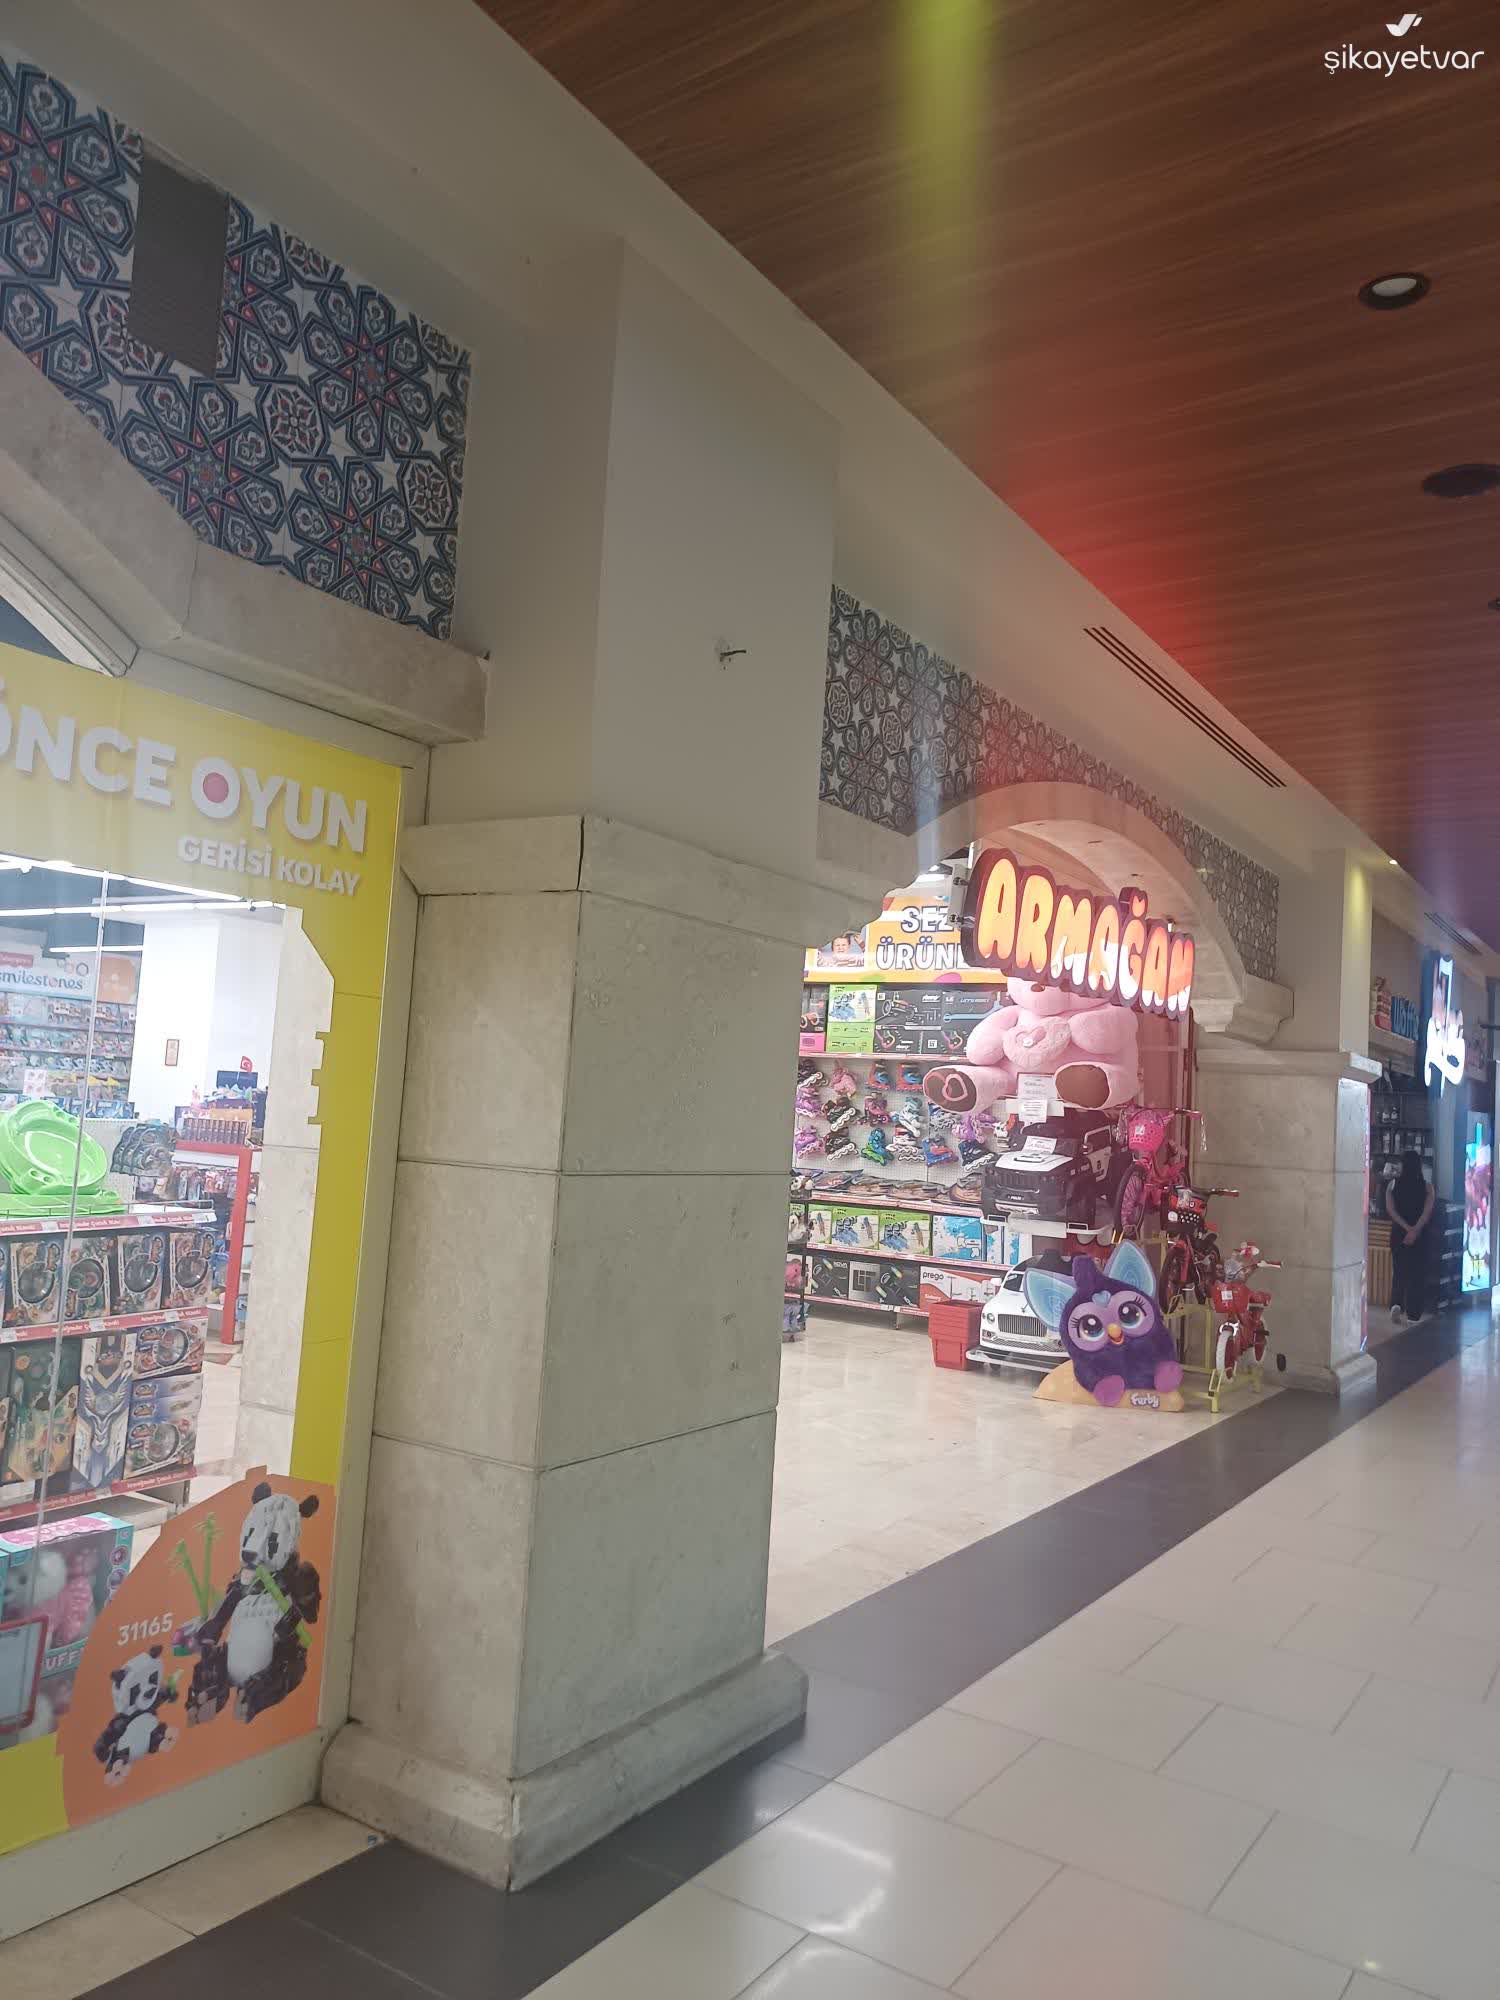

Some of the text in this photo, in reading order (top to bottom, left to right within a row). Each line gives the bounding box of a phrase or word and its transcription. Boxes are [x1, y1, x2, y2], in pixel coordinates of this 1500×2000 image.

[0, 677, 367, 854] NCE OYUN
[178, 835, 361, 896] GERİSİ KOLAY
[977, 858, 1194, 1012] ARMAĞAN
[0, 969, 83, 990] milestones
[922, 1271, 944, 1281] prego
[1130, 1392, 1160, 1408] Furby
[117, 1612, 173, 1646] 31165
